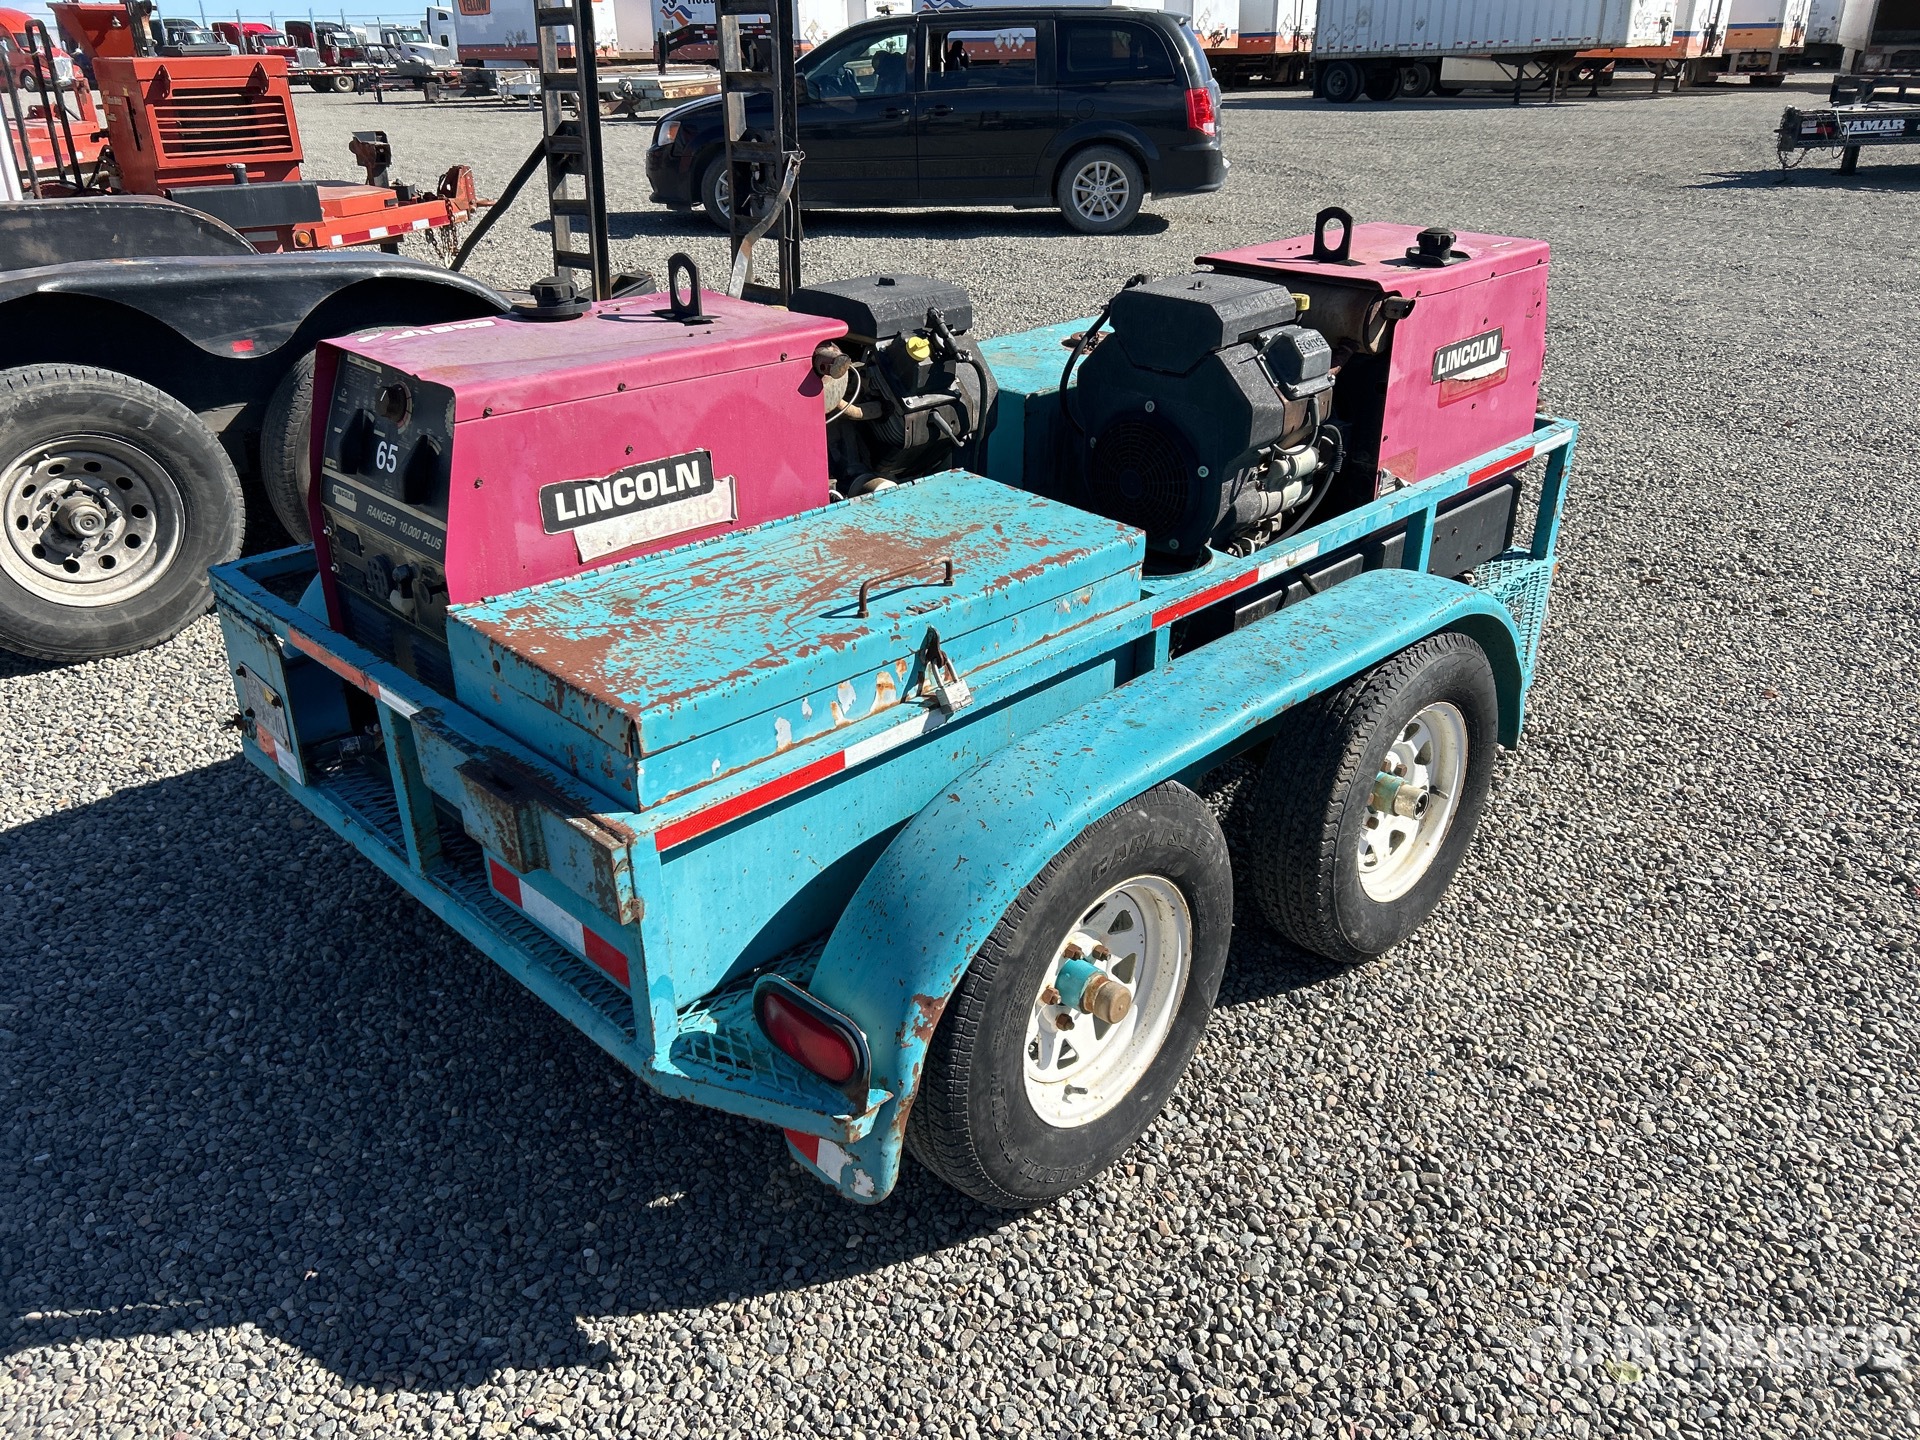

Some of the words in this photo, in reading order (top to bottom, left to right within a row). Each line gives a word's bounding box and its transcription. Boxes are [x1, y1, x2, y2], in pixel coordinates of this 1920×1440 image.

[1437, 335, 1498, 375] LINCOLN
[376, 441, 398, 473] 65
[554, 460, 701, 522] LINCOLN
[366, 505, 397, 528] RANGER
[399, 521, 422, 540] 10,000
[421, 532, 443, 550] PLUS
[1091, 828, 1208, 885] CARLISLE
